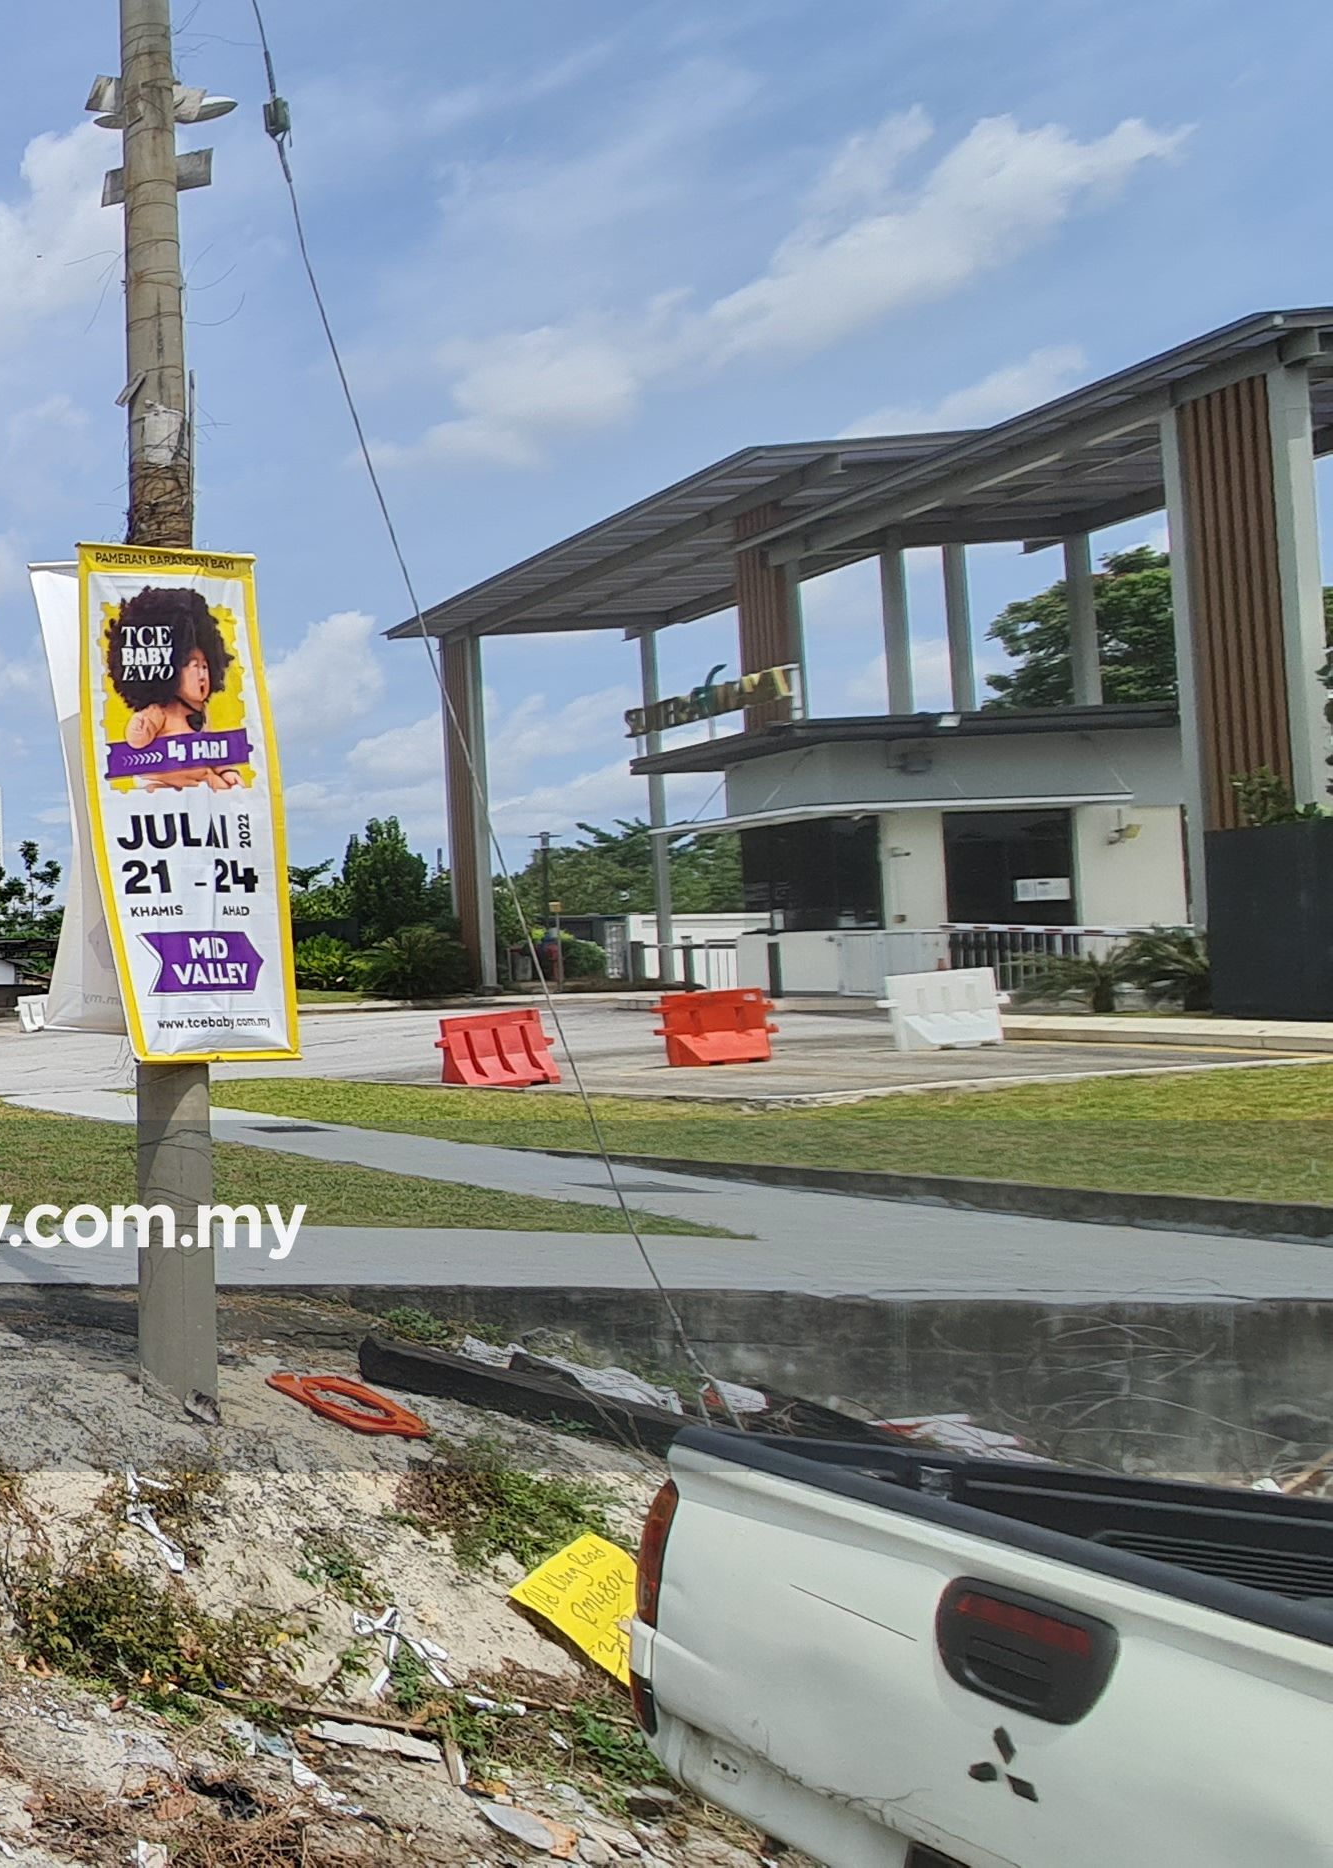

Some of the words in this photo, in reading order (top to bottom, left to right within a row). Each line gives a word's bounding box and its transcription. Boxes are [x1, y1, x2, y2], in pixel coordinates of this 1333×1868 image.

[95, 552, 146, 565] PAMERAN
[150, 555, 209, 568] BARANGAN
[211, 558, 235, 571] BAYI
[120, 625, 173, 648] TCE
[121, 647, 174, 667] BABY
[121, 665, 175, 682] EXPO
[167, 740, 187, 762] 4
[192, 739, 229, 761] HARI
[116, 812, 230, 851] JULAI
[237, 813, 252, 849] 2022
[121, 859, 173, 895] 21
[214, 859, 259, 894] 24
[130, 904, 184, 918] KHAMIS
[222, 905, 250, 917] AHAD
[171, 962, 249, 985] VALLEY
[156, 1015, 271, 1030] www.tcebaby.com.my
